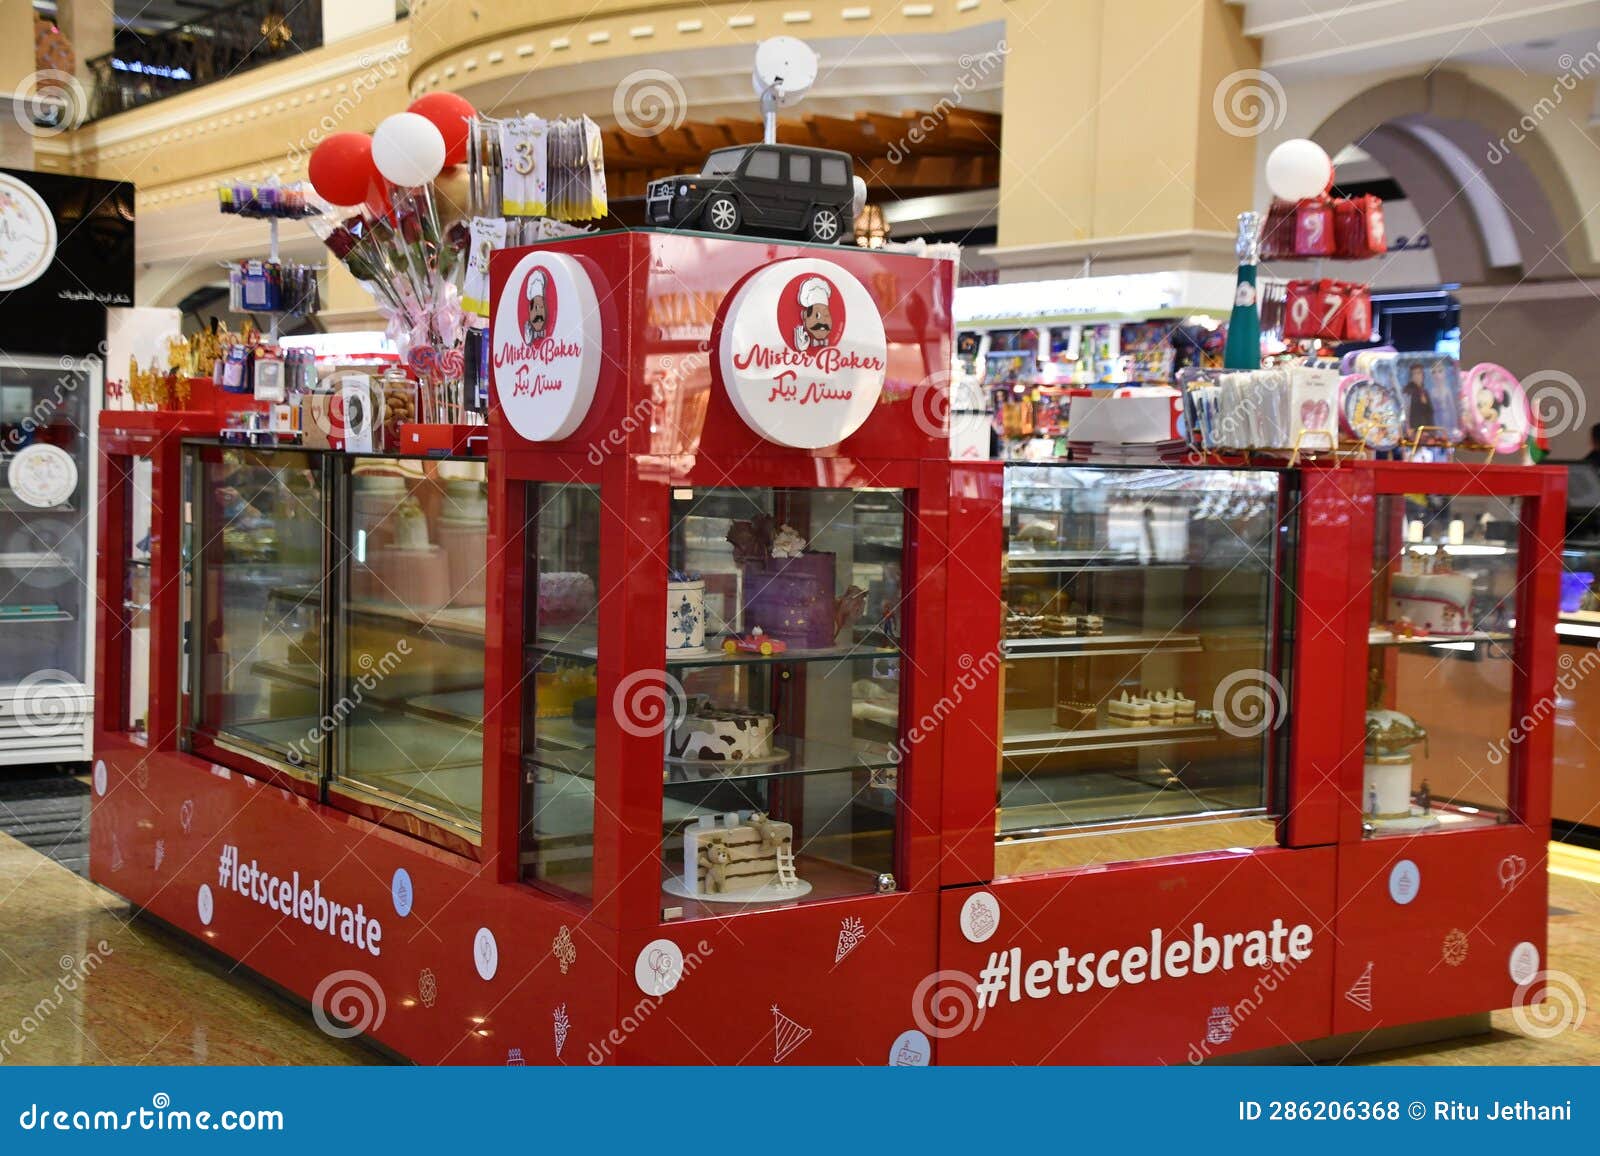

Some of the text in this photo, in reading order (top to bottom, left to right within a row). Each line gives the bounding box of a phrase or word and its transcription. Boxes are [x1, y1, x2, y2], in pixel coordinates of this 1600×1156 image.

[515, 142, 535, 176] 3
[1303, 212, 1324, 248] 9
[1321, 294, 1342, 330] 7
[495, 338, 581, 368] Mister Baker
[733, 344, 884, 374] Mister Baker
[218, 844, 382, 956] #letscelebrate
[976, 918, 1313, 1010] #letscelebrate
